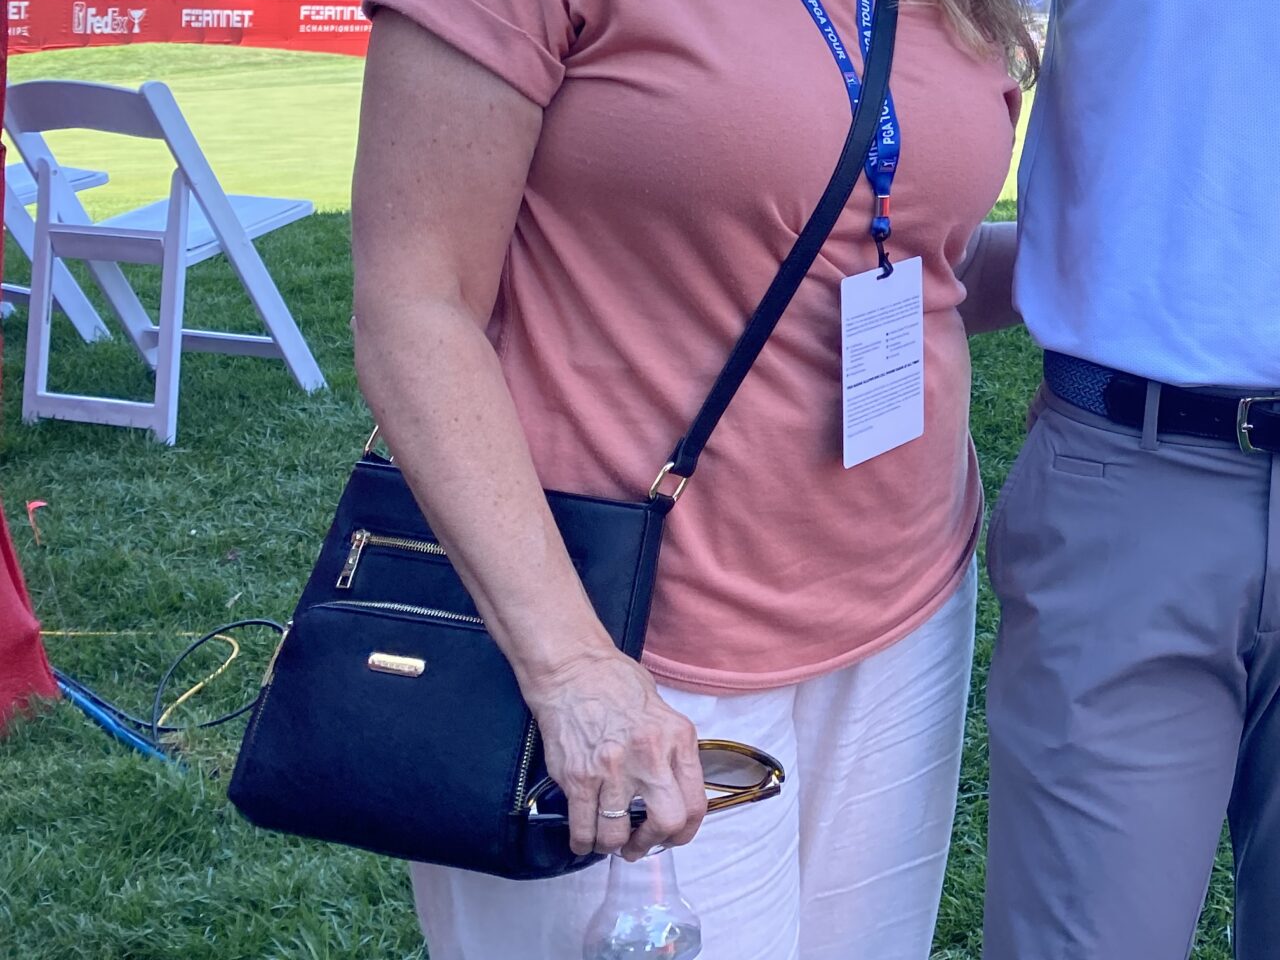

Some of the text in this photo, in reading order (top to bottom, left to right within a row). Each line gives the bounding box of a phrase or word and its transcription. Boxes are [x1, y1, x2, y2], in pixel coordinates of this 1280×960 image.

[86, 7, 129, 34] FedEx
[181, 9, 254, 28] FORTINET
[299, 5, 367, 21] FORTINE
[807, 0, 846, 59] PGA TOUR
[882, 122, 895, 145] PGA
